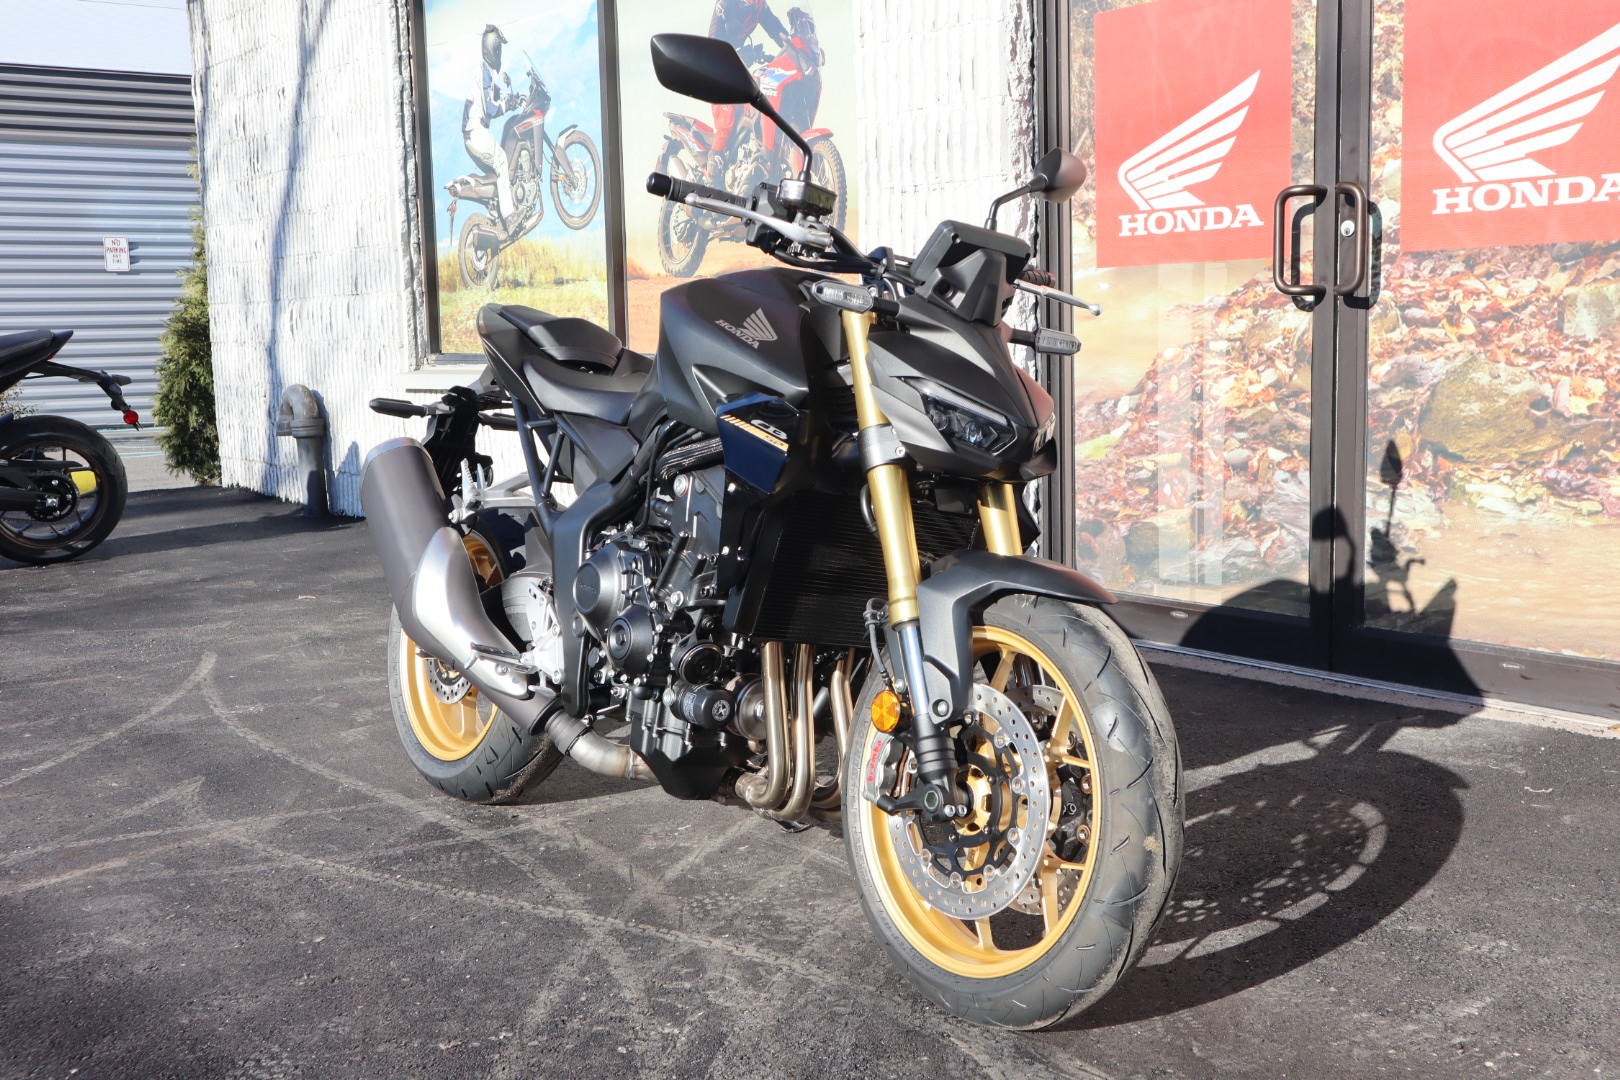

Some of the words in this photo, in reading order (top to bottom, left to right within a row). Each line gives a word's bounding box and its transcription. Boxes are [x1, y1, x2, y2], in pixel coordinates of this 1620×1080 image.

[1432, 172, 1620, 215] HONDA
[1118, 204, 1264, 237] HONDA
[714, 319, 760, 349] HONDA
[750, 419, 788, 440] CB
[866, 739, 883, 782] brembo
